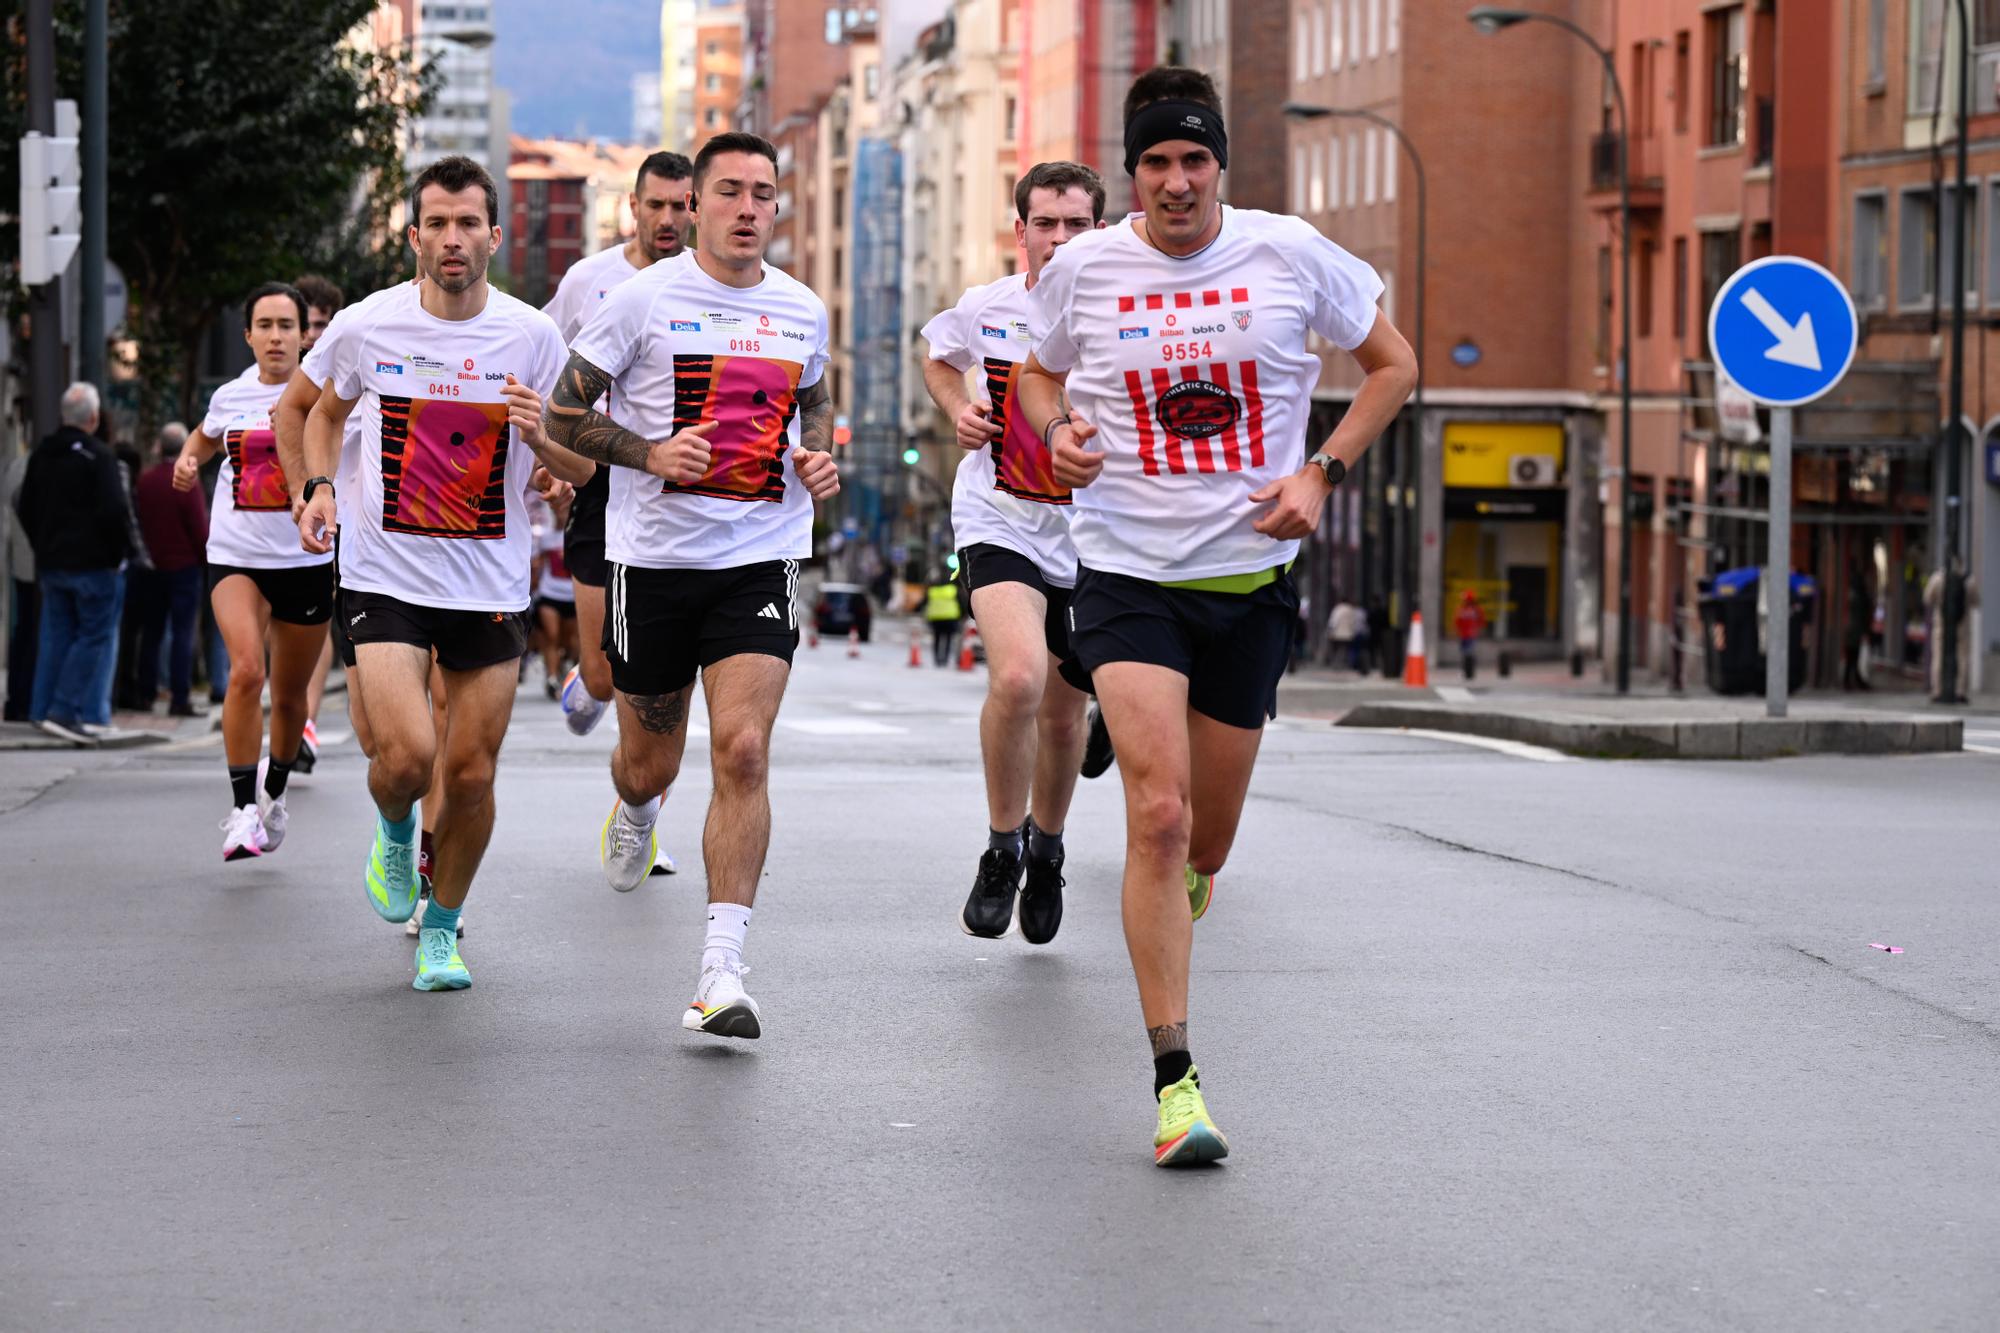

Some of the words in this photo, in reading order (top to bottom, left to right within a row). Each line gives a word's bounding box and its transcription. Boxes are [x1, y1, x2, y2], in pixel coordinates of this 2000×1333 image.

[756, 328, 778, 337] Bilbao
[1160, 329, 1184, 337] Bilbao
[1192, 326, 1215, 335] bbk
[730, 339, 760, 352] 0185
[1162, 340, 1213, 361] 9554
[457, 372, 480, 381] Bilbao
[429, 383, 460, 397] 0415
